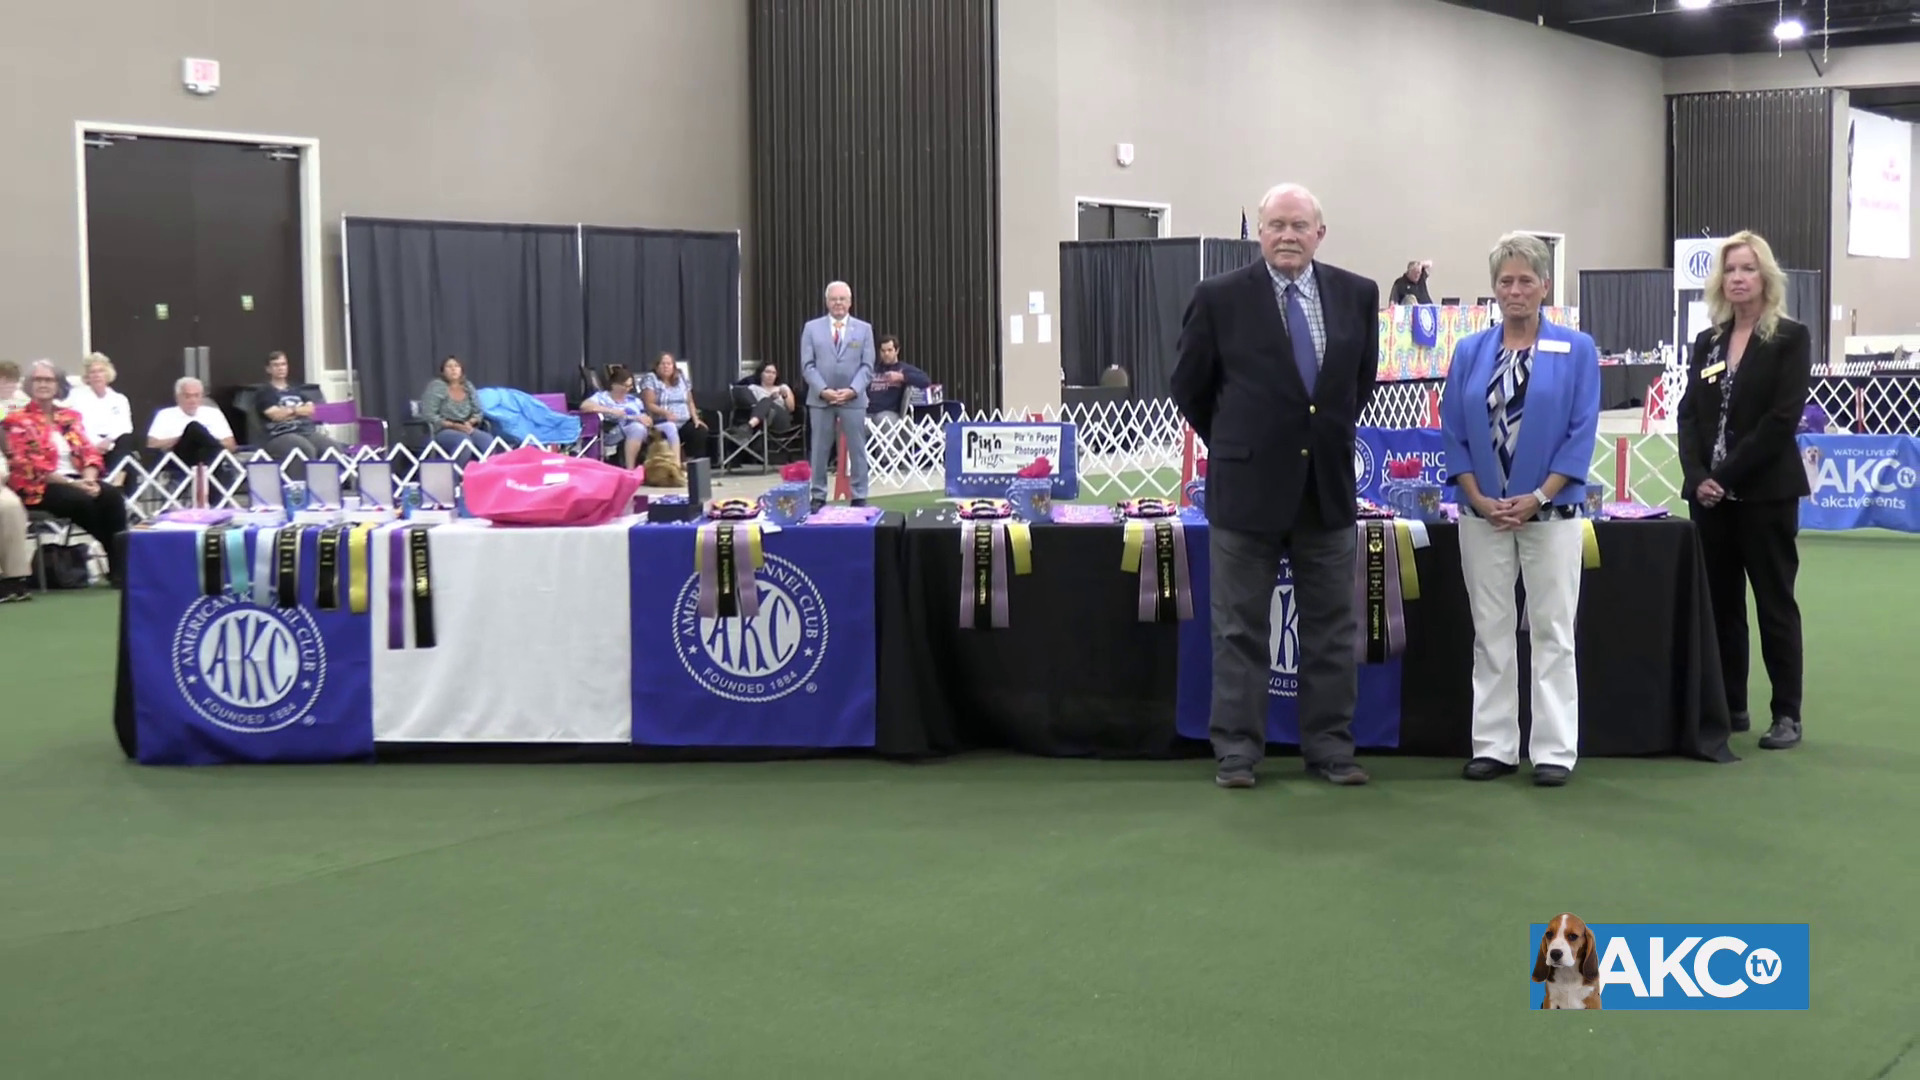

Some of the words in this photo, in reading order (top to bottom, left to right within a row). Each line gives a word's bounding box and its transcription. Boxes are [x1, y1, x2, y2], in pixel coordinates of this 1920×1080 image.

[967, 431, 1002, 459] Pix'n
[1014, 432, 1026, 442] Pix
[1036, 432, 1058, 445] Pages
[1014, 446, 1058, 458] Photography
[1833, 448, 1865, 456] WATCH
[1866, 449, 1885, 457] LIVE
[1886, 449, 1898, 457] ON
[1814, 458, 1901, 493] AKC
[1821, 496, 1906, 509] akc.tv/eents
[707, 587, 795, 673] AKC
[799, 594, 818, 639] CLUB
[206, 613, 294, 704] AKC
[299, 628, 317, 673] CLUB
[703, 667, 765, 693] FOUNDED
[770, 671, 799, 690] 1884
[202, 697, 265, 724] FOUNDED
[268, 702, 297, 722] 1884
